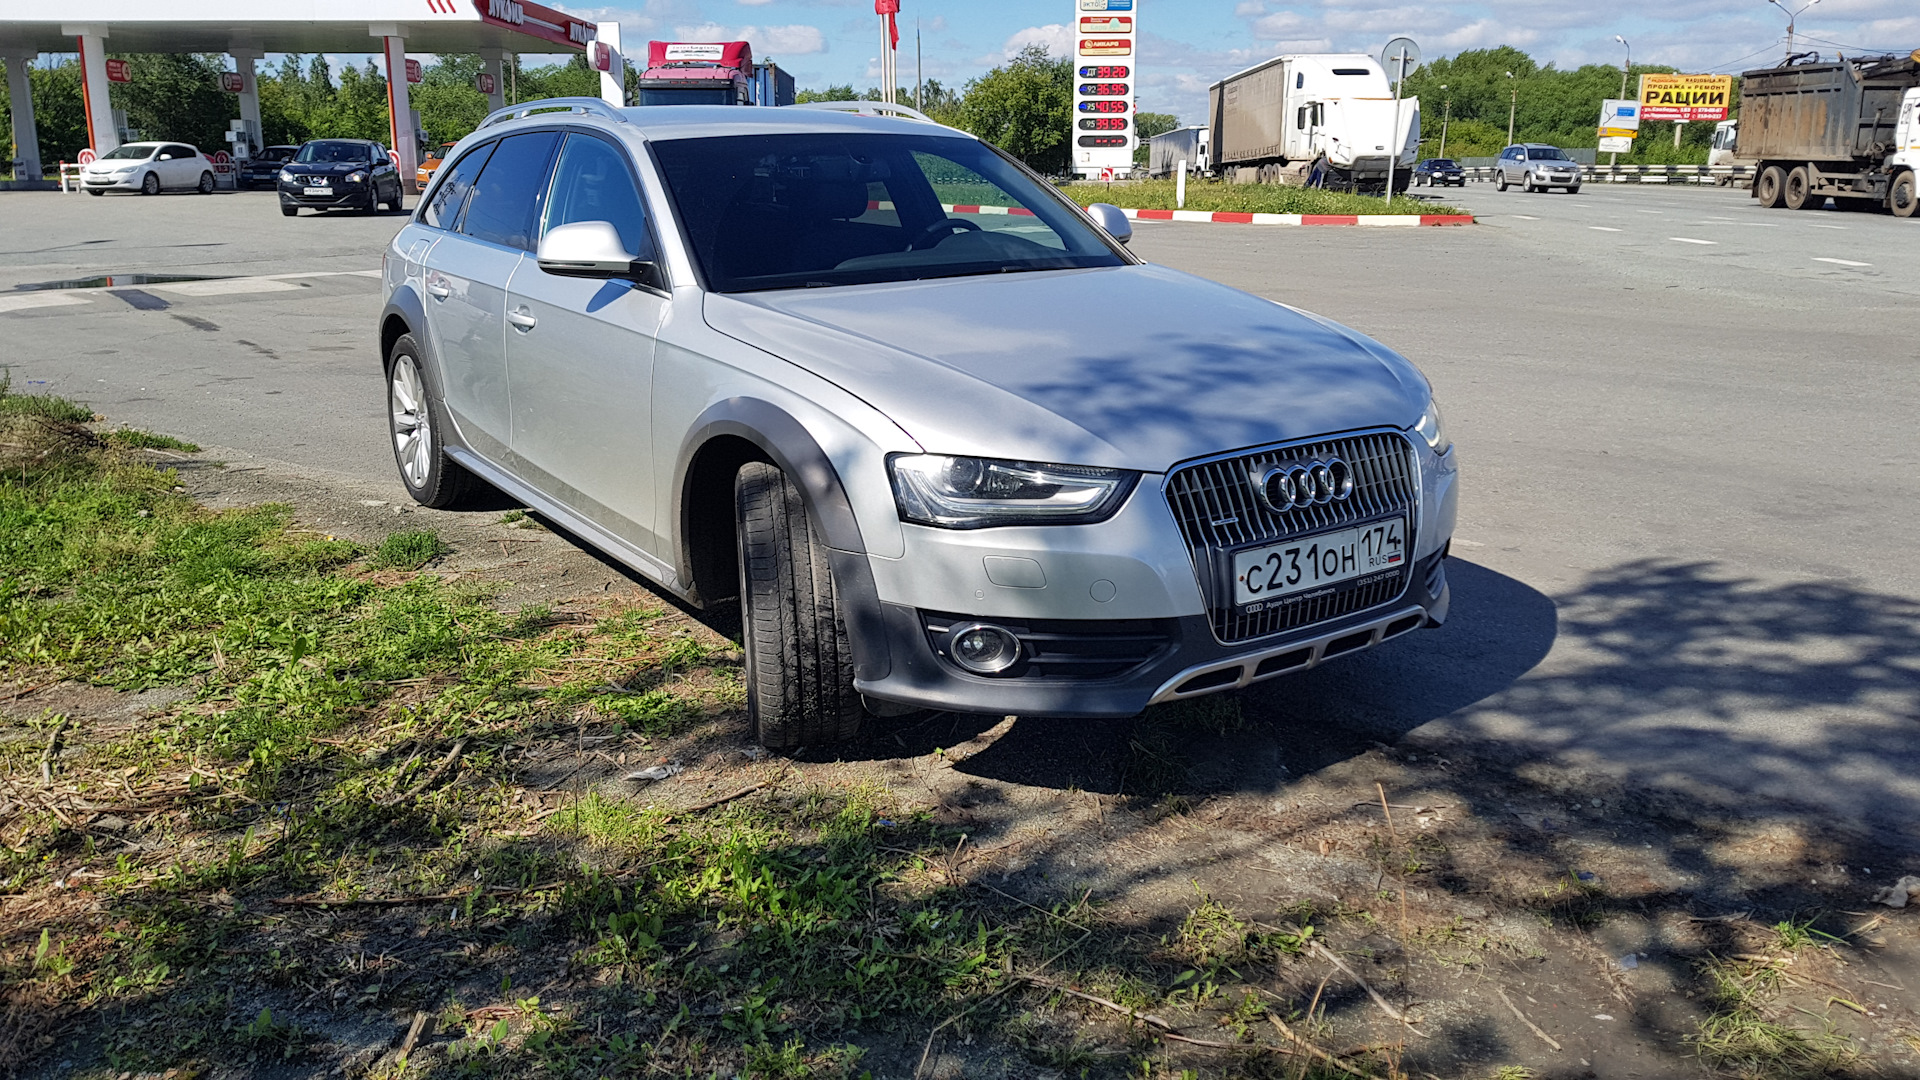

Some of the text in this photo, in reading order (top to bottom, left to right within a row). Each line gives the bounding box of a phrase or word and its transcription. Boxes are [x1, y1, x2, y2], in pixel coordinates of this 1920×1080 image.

[1646, 91, 1725, 105] РАЦИИ
[1086, 120, 1095, 128] 95
[1246, 523, 1399, 594] С231ОН 174
[1369, 554, 1388, 568] RUS
[1265, 601, 1283, 609] Ауди
[1283, 595, 1303, 605] Центр
[1303, 587, 1336, 600] Челябинск
